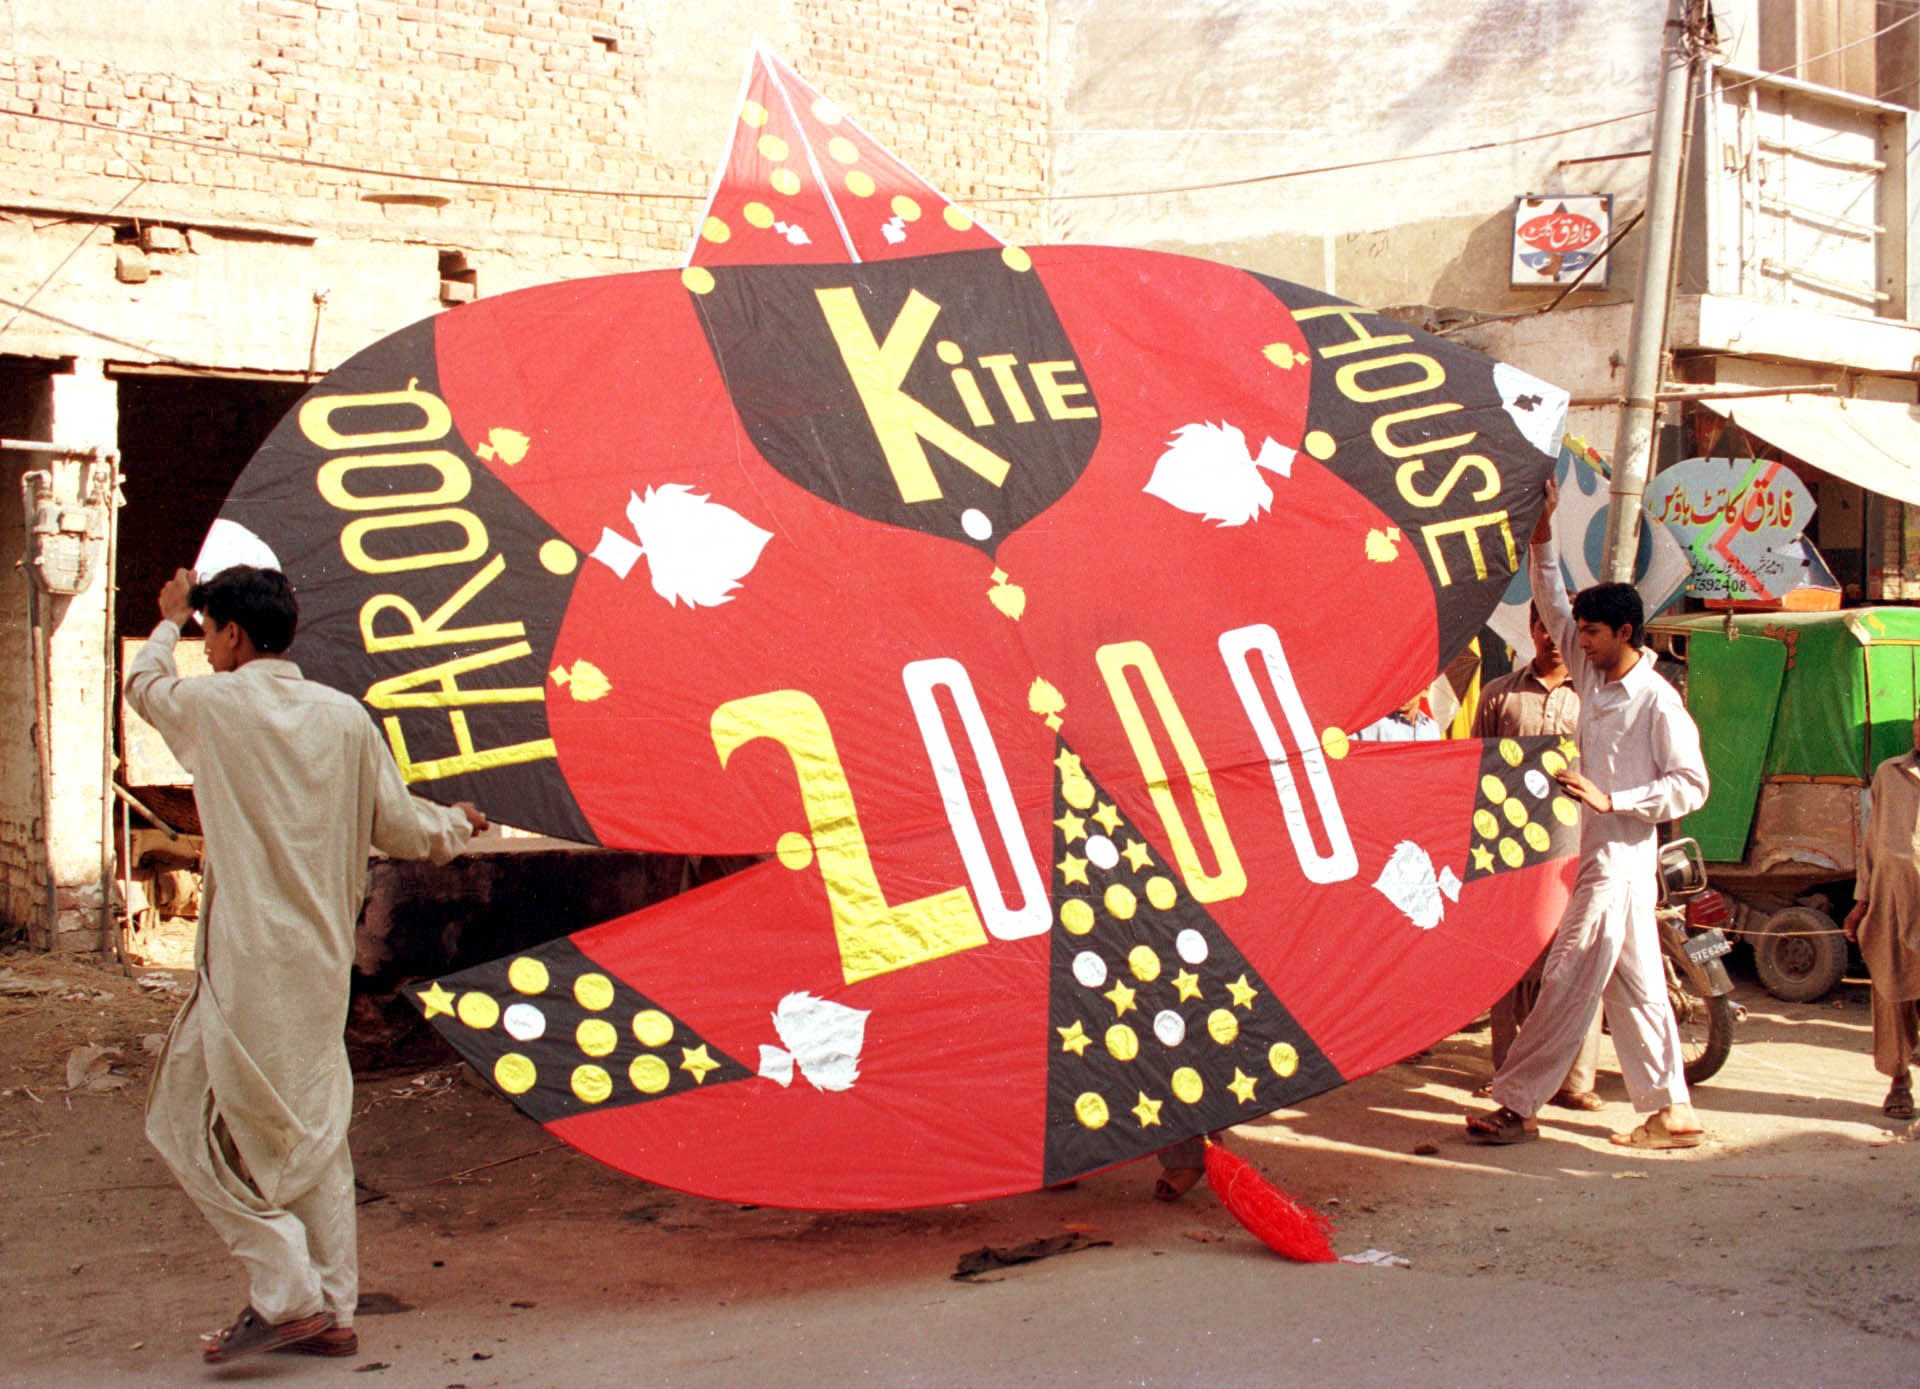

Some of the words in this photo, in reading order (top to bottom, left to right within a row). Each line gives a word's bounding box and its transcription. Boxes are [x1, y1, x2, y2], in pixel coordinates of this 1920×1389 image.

[1549, 218, 1593, 249] فاروق
[1290, 305, 1520, 588] HOUSE
[1741, 478, 1795, 532] فاروق
[710, 623, 1359, 986] 2000
